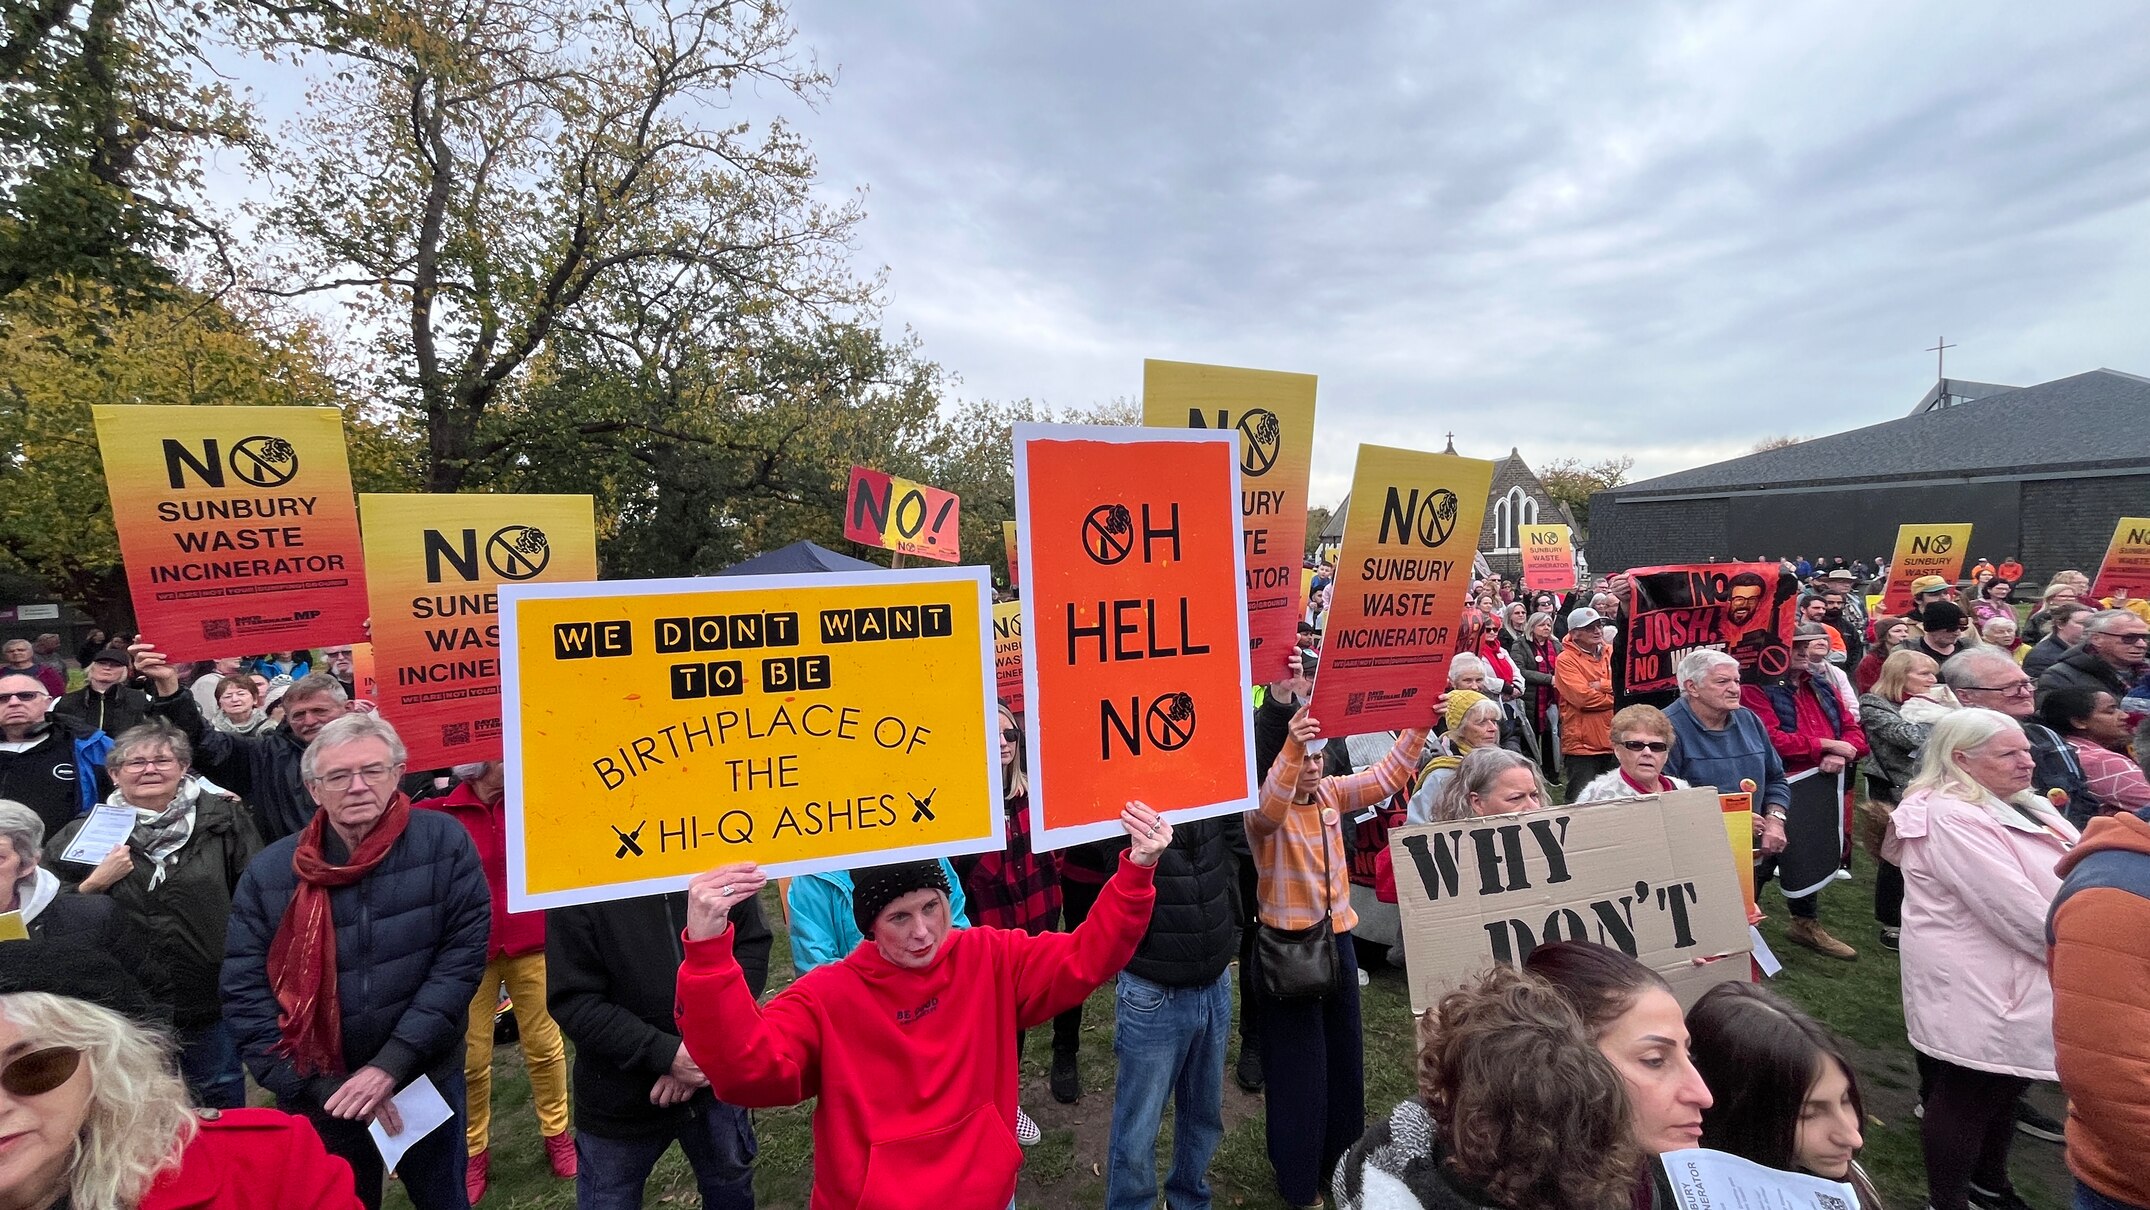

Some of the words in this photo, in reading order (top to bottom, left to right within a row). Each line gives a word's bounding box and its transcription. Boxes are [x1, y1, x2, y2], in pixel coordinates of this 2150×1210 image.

[162, 436, 298, 488] NO
[157, 497, 317, 522] SUNBURY
[853, 478, 954, 545] NO!
[1378, 486, 1458, 548] NO
[174, 527, 304, 553] WASTE
[1081, 502, 1182, 565] OH
[150, 555, 345, 584] INCINERATOR
[424, 526, 550, 584] NO
[1362, 558, 1454, 582] SUNBURY
[1904, 558, 1952, 566] SUNBURY
[1363, 593, 1436, 617] WASTE
[1692, 571, 1728, 606] NO
[294, 610, 321, 621] MP
[412, 594, 498, 619] SUNB
[424, 628, 500, 652] WAS
[557, 623, 623, 655] WE
[823, 608, 944, 637] WANT
[1067, 597, 1211, 665] HELL
[1336, 626, 1448, 650] INCINERATOR
[1636, 608, 1717, 654] JOSH,
[398, 658, 500, 686] INCINE
[679, 665, 737, 692] TO
[770, 659, 822, 686] BE
[995, 654, 1022, 668] WAS
[1634, 655, 1658, 682] NO
[422, 694, 443, 702] ARE
[445, 691, 466, 699] NOT
[470, 687, 497, 695] YOUR
[1401, 688, 1418, 698] MP
[1100, 692, 1196, 760] NO
[593, 704, 860, 791] BIRTHPLACE
[874, 716, 931, 755] OF
[725, 754, 800, 792] THE
[658, 808, 754, 852] HI-Q
[772, 794, 896, 840] ASHES
[1402, 816, 1570, 900] WHY
[1484, 881, 1698, 972] DON'T
[1682, 1182, 1698, 1210] BURY
[1688, 1162, 1711, 1210] NERATOR
